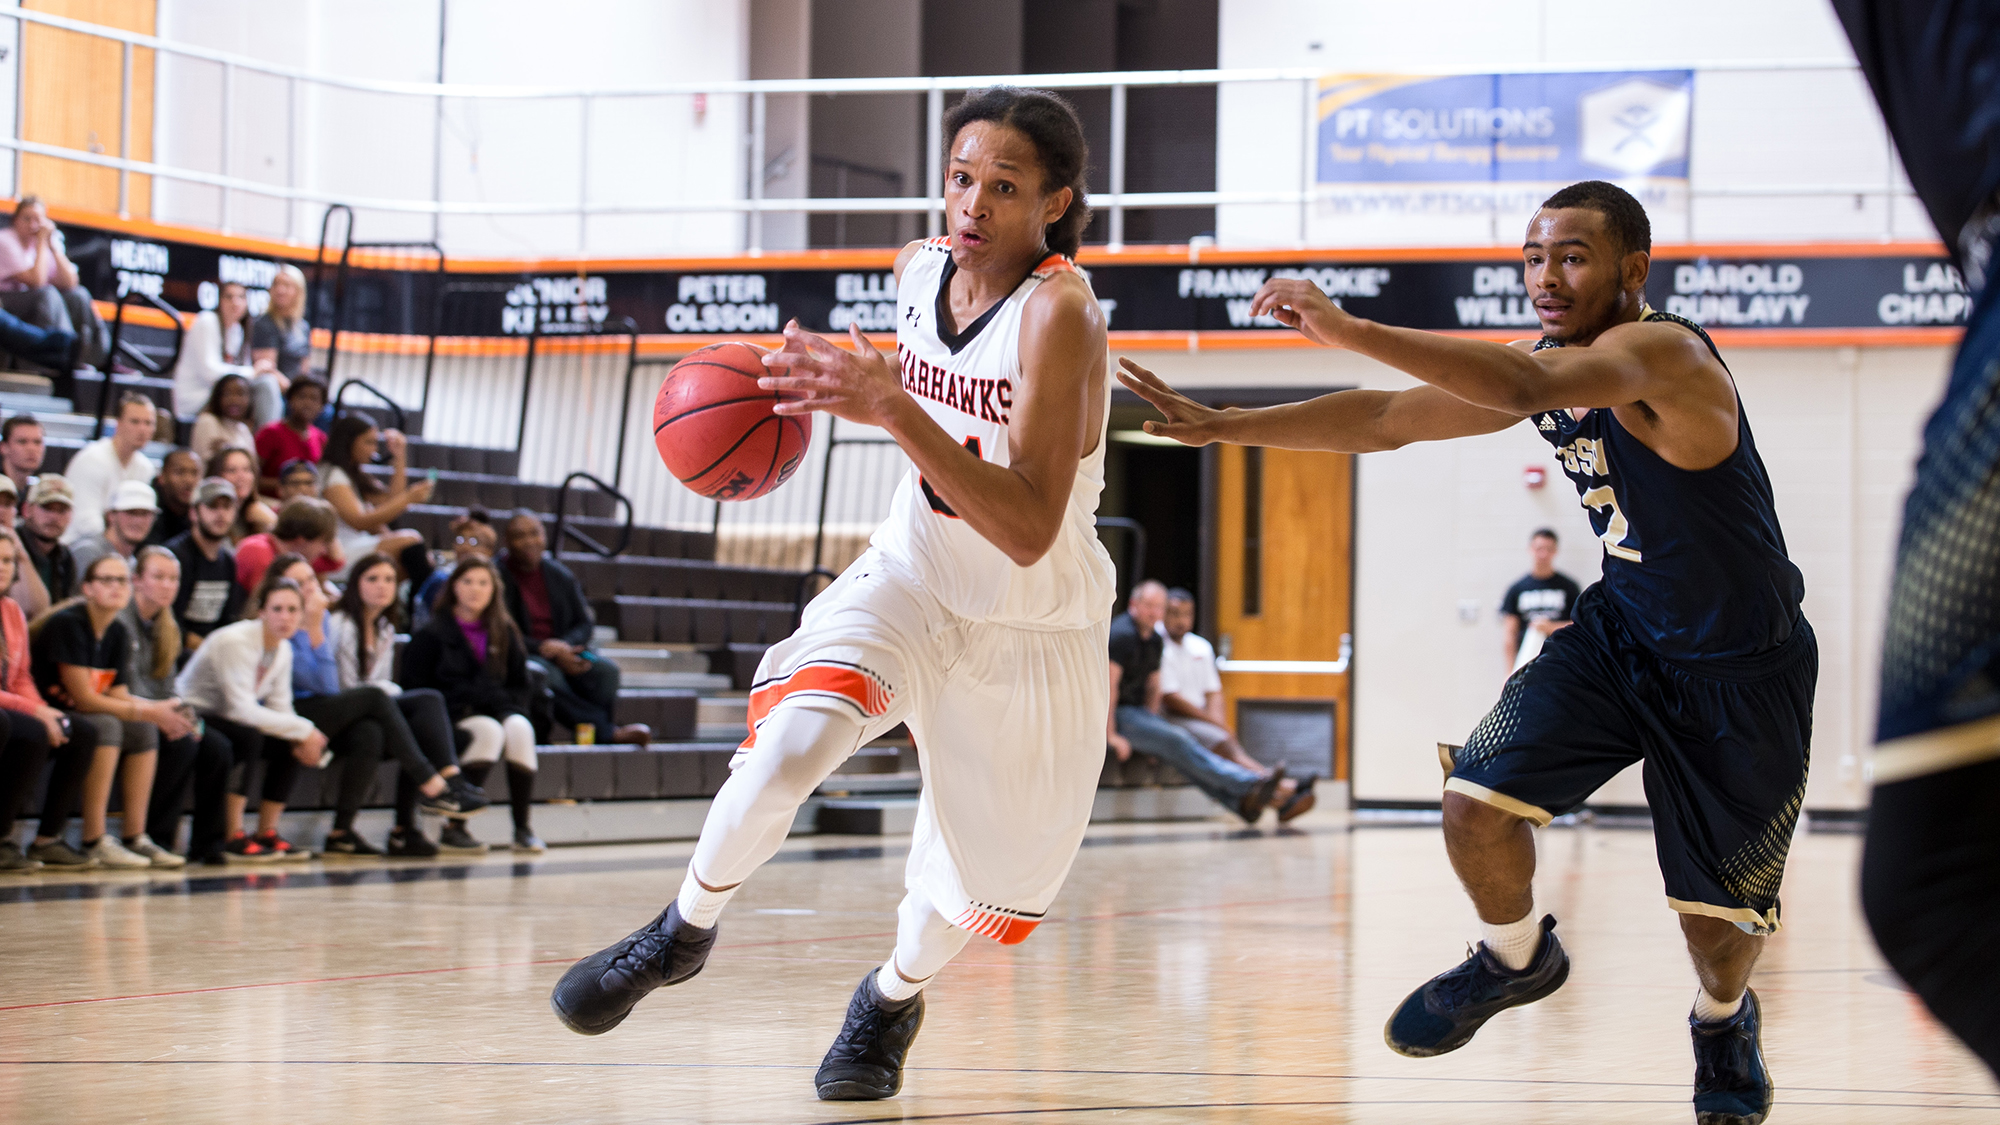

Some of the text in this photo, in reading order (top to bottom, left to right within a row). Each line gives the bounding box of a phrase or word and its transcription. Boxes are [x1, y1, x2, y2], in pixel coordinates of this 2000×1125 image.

[1336, 106, 1556, 139] PT SOLUTIONS
[111, 239, 169, 274] HEATH
[678, 275, 766, 303] PETER
[1474, 267, 1525, 295] DR.
[1675, 264, 1803, 294] DAROLD
[665, 303, 779, 332] OLSSON
[1666, 295, 1810, 326] DUNLAVY
